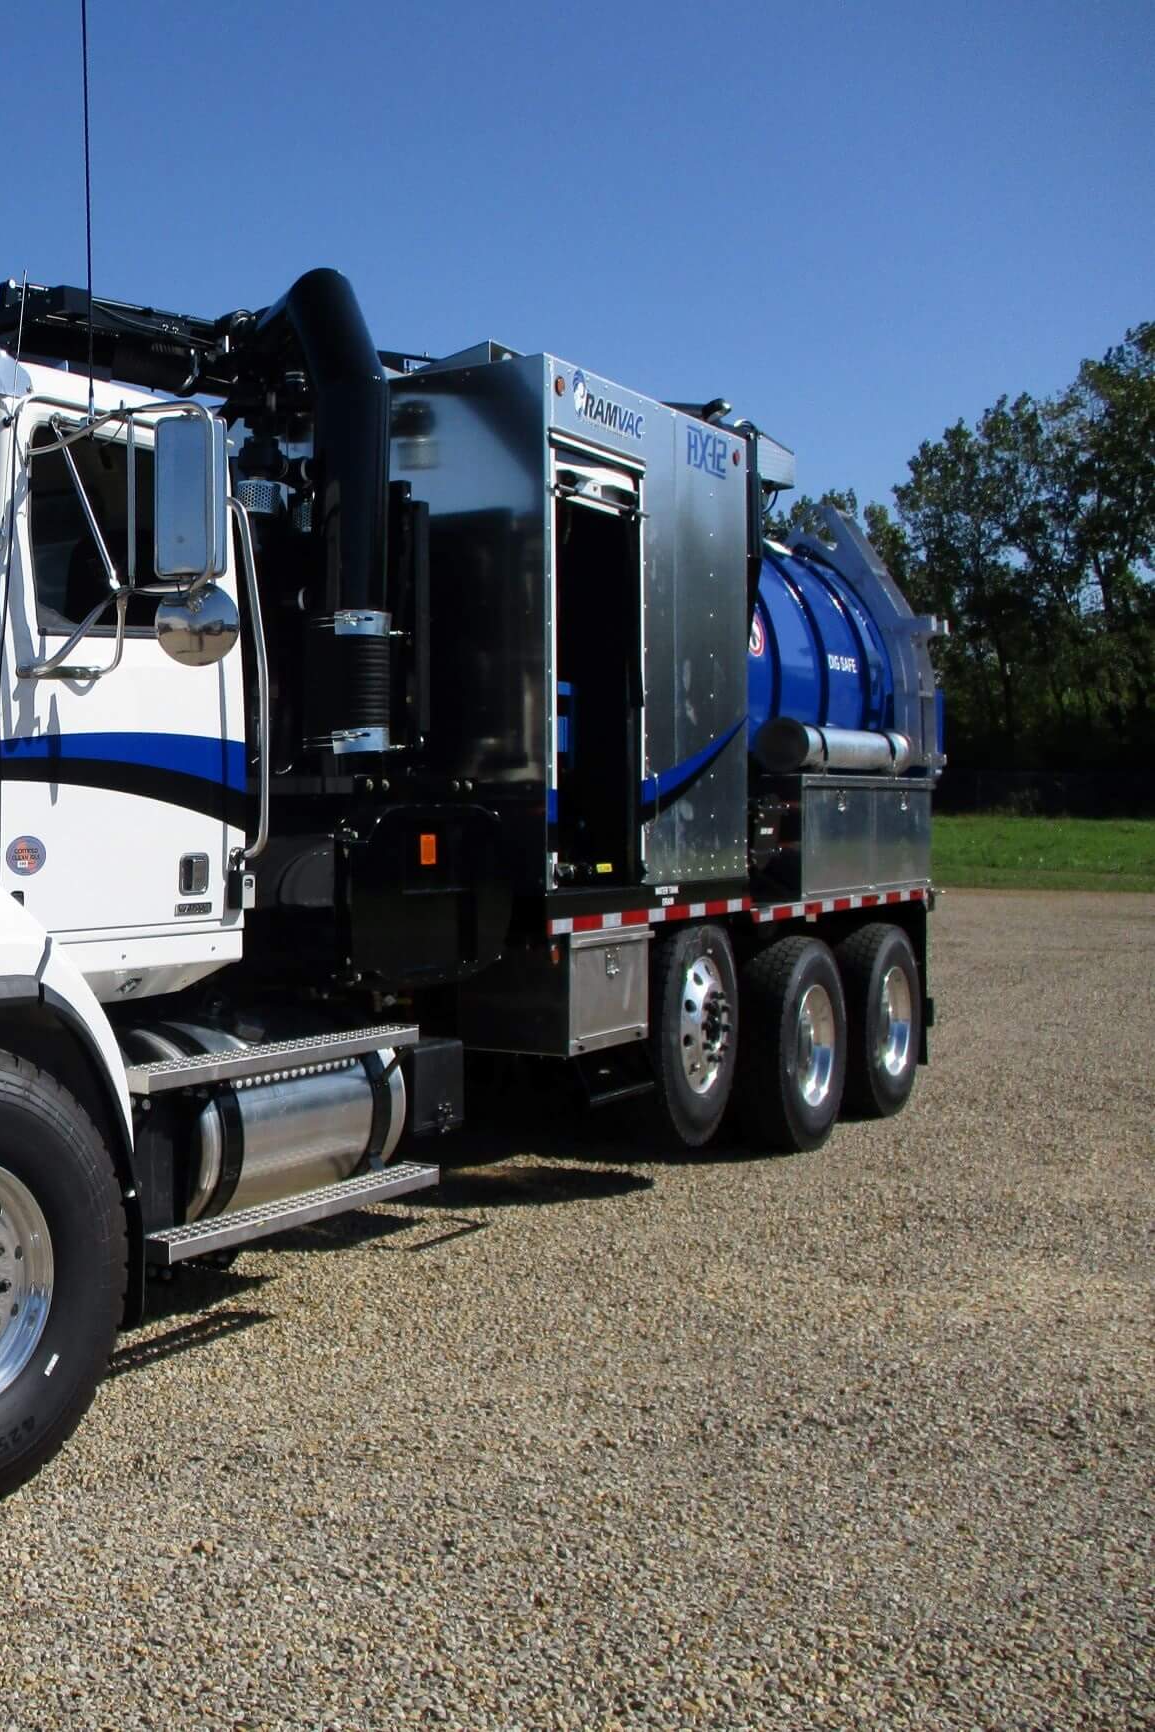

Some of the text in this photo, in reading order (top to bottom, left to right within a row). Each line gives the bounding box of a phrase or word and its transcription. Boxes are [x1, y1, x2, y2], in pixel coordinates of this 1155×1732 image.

[584, 392, 643, 439] RAMVAC
[687, 425, 727, 480] HX-12
[840, 656, 858, 673] SAFE
